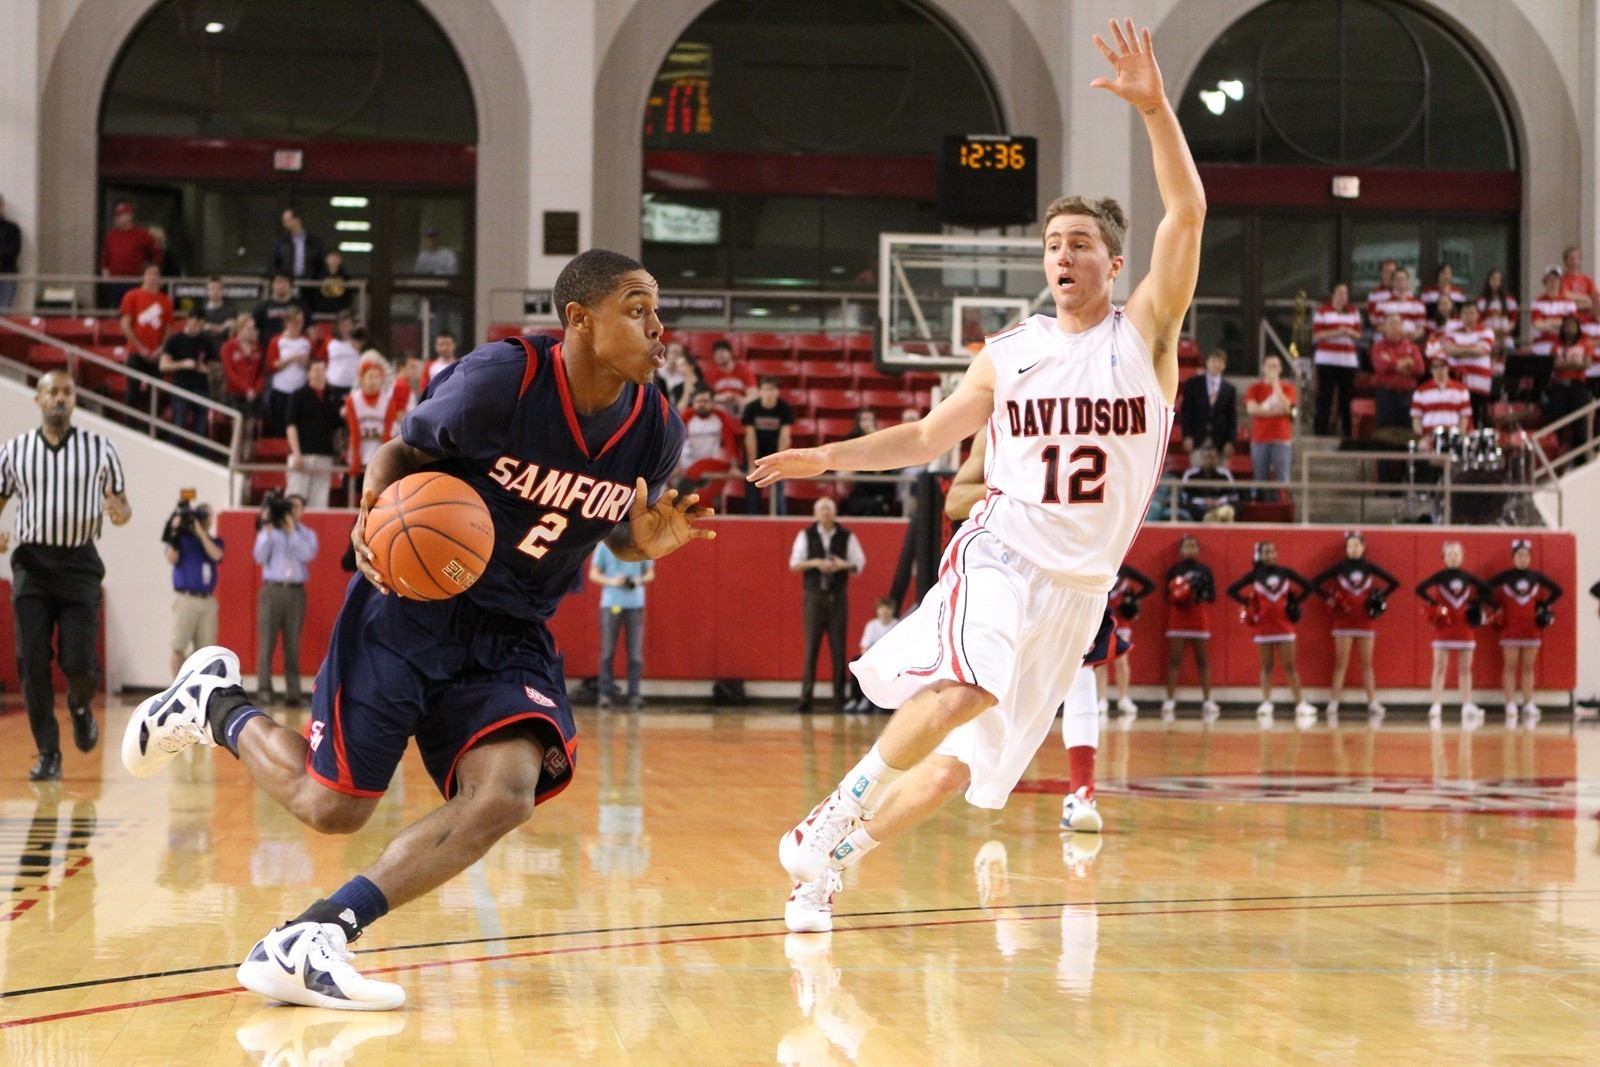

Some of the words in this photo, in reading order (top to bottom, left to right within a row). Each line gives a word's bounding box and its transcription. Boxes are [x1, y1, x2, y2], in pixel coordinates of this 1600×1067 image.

[960, 143, 1026, 170] 12:36
[1007, 395, 1147, 438] DAVIDSON
[1041, 444, 1107, 504] 12
[515, 510, 569, 560] 2
